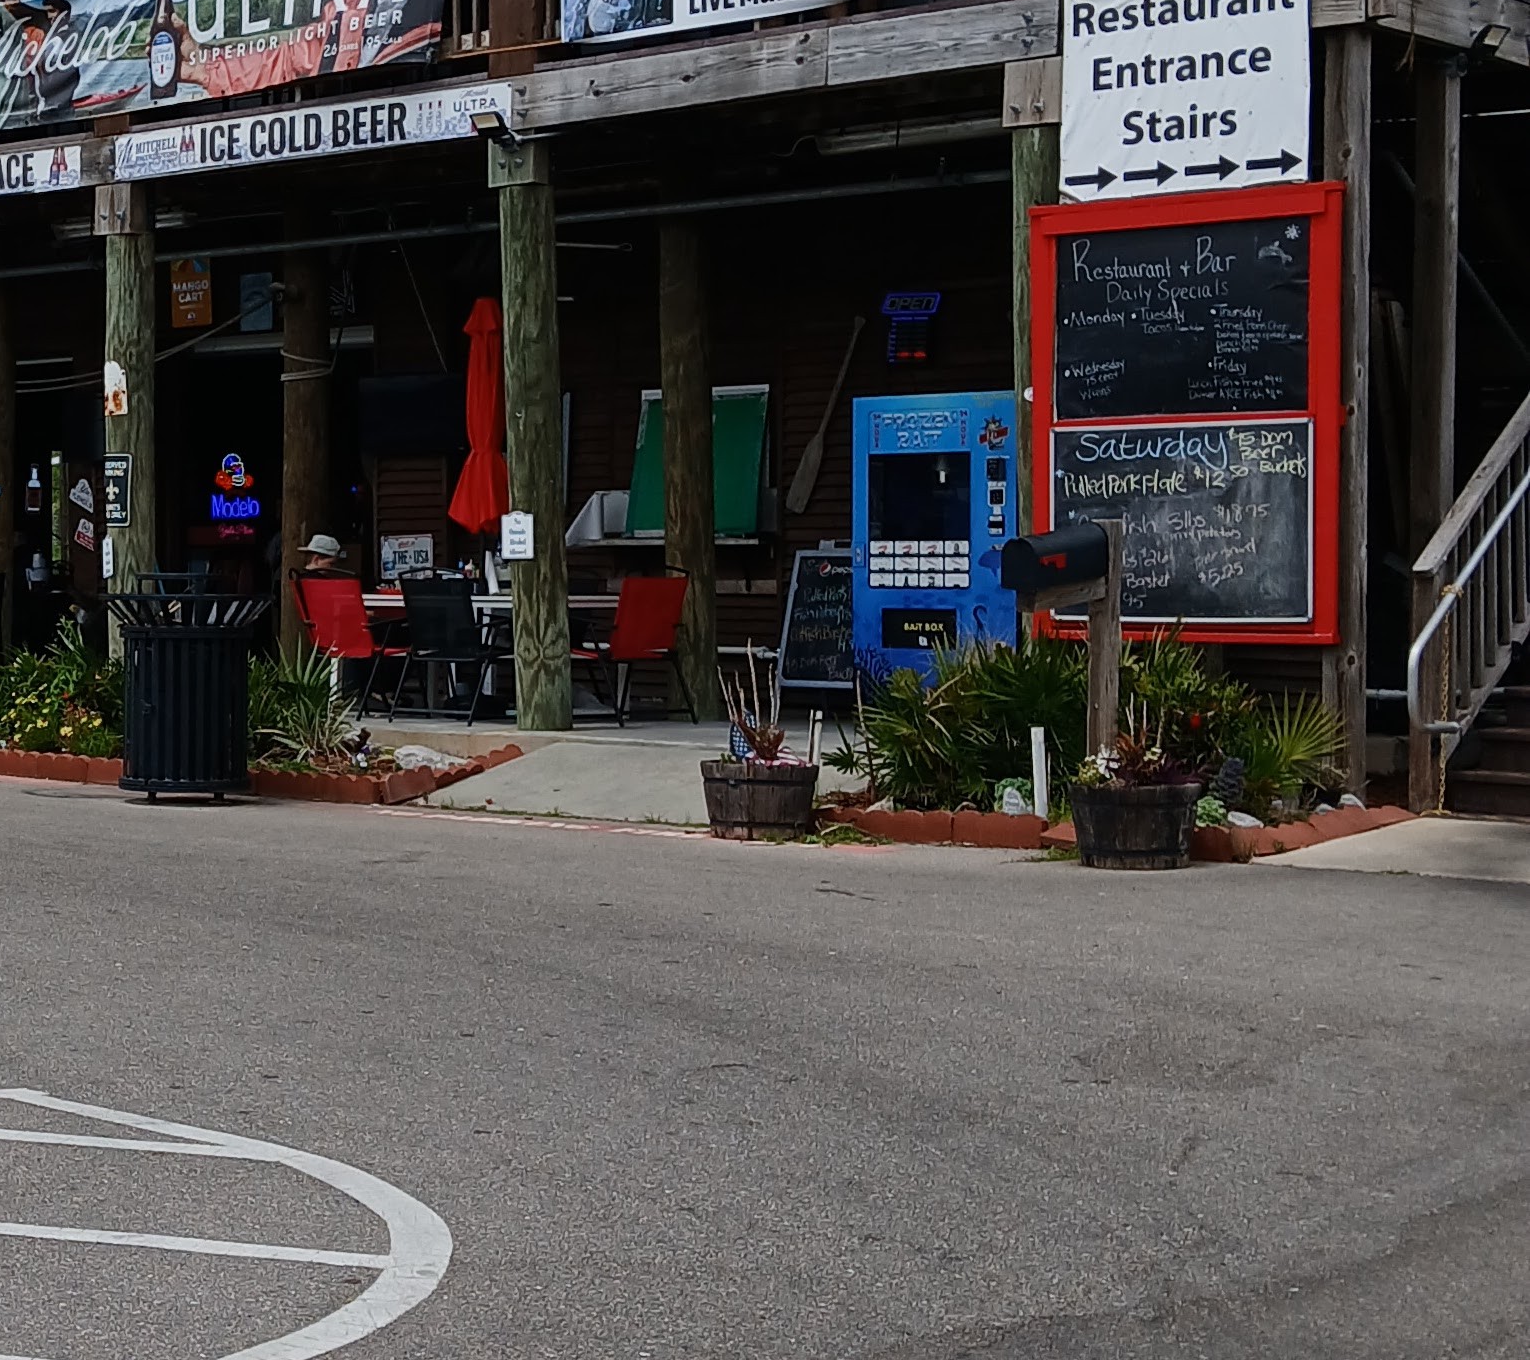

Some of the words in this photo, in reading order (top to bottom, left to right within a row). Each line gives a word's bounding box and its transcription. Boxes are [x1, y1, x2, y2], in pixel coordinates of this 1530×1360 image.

[188, 35, 278, 66] SUPERIOR
[288, 19, 339, 47] LIGHT
[349, 9, 403, 31] BEER
[1092, 46, 1272, 91] Entrance
[199, 121, 243, 164] ICE
[250, 112, 323, 159] COLD
[332, 102, 408, 147] BEER
[1122, 103, 1238, 145] Stairs
[135, 137, 177, 154] MITCHELL
[1072, 238, 1172, 282] Restaurant
[1196, 235, 1238, 275] Bar
[172, 280, 209, 293] MANGO
[178, 291, 204, 303] CART
[1107, 281, 1152, 306] Daily
[1158, 278, 1229, 316] Specials
[885, 296, 936, 311] OPEN
[1070, 307, 1125, 328] Monday
[1213, 356, 1247, 376] Friday
[1075, 429, 1228, 471] Saturday
[212, 494, 259, 518] Modelo
